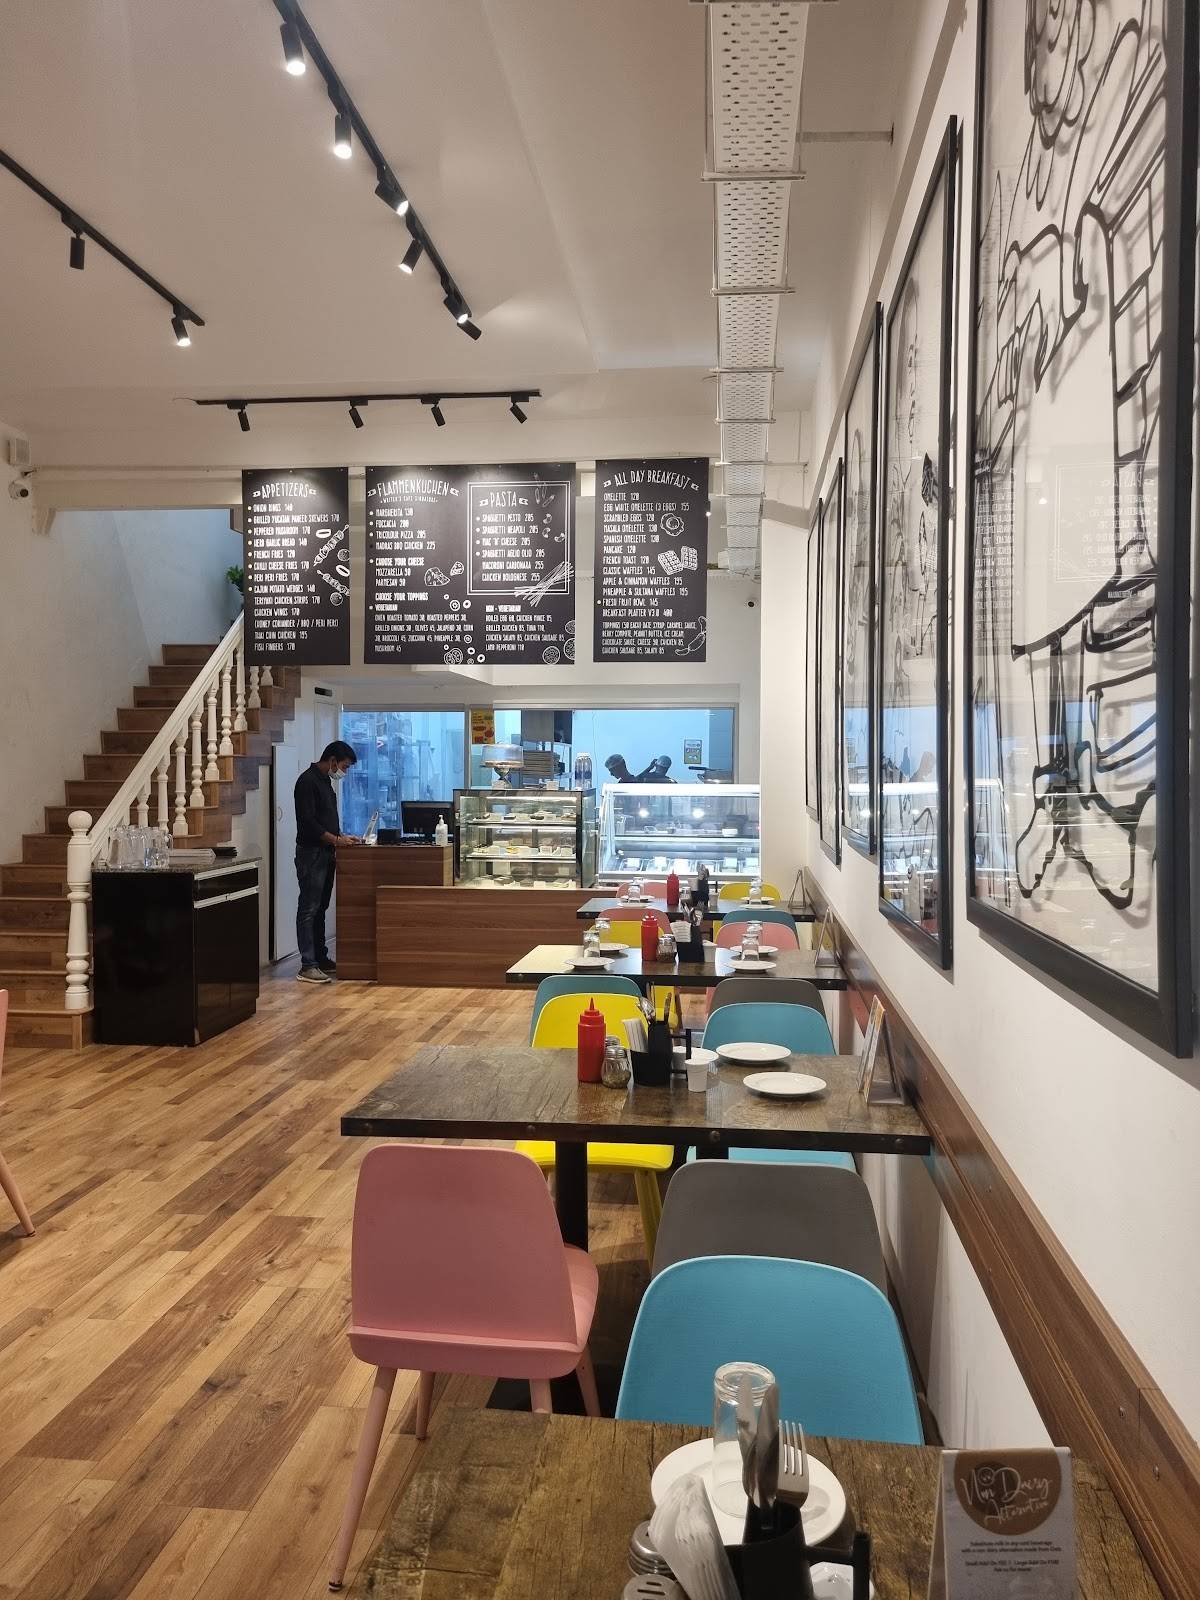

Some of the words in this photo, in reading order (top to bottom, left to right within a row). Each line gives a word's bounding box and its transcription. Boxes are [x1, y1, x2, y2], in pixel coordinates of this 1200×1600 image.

[614, 472, 628, 486] ALL
[631, 470, 644, 483] DAY
[648, 470, 691, 490] BREAKFAST
[262, 483, 309, 499] APPETIZERS
[377, 479, 449, 497] FLAMMENKUCHEN
[490, 491, 516, 507] PASTA
[604, 493, 626, 501] OMELETTE
[631, 503, 653, 511] OMELETTE
[254, 516, 270, 524] GRILLED
[309, 514, 328, 522] SKEWERS
[604, 514, 628, 522] SCRAMBLED
[302, 526, 310, 534] 170
[604, 524, 620, 532] MASALA
[622, 524, 644, 532] OMELETTE
[282, 538, 295, 546] BREAD
[624, 535, 646, 543] OMELETTE
[395, 558, 406, 566] YOUR
[408, 557, 424, 565] CHEESE
[269, 562, 284, 570] CHEESE
[376, 568, 403, 576] MOZZARELLA
[603, 598, 617, 606] FRESH
[619, 598, 631, 606] FRUIT
[633, 598, 646, 606] BOWL
